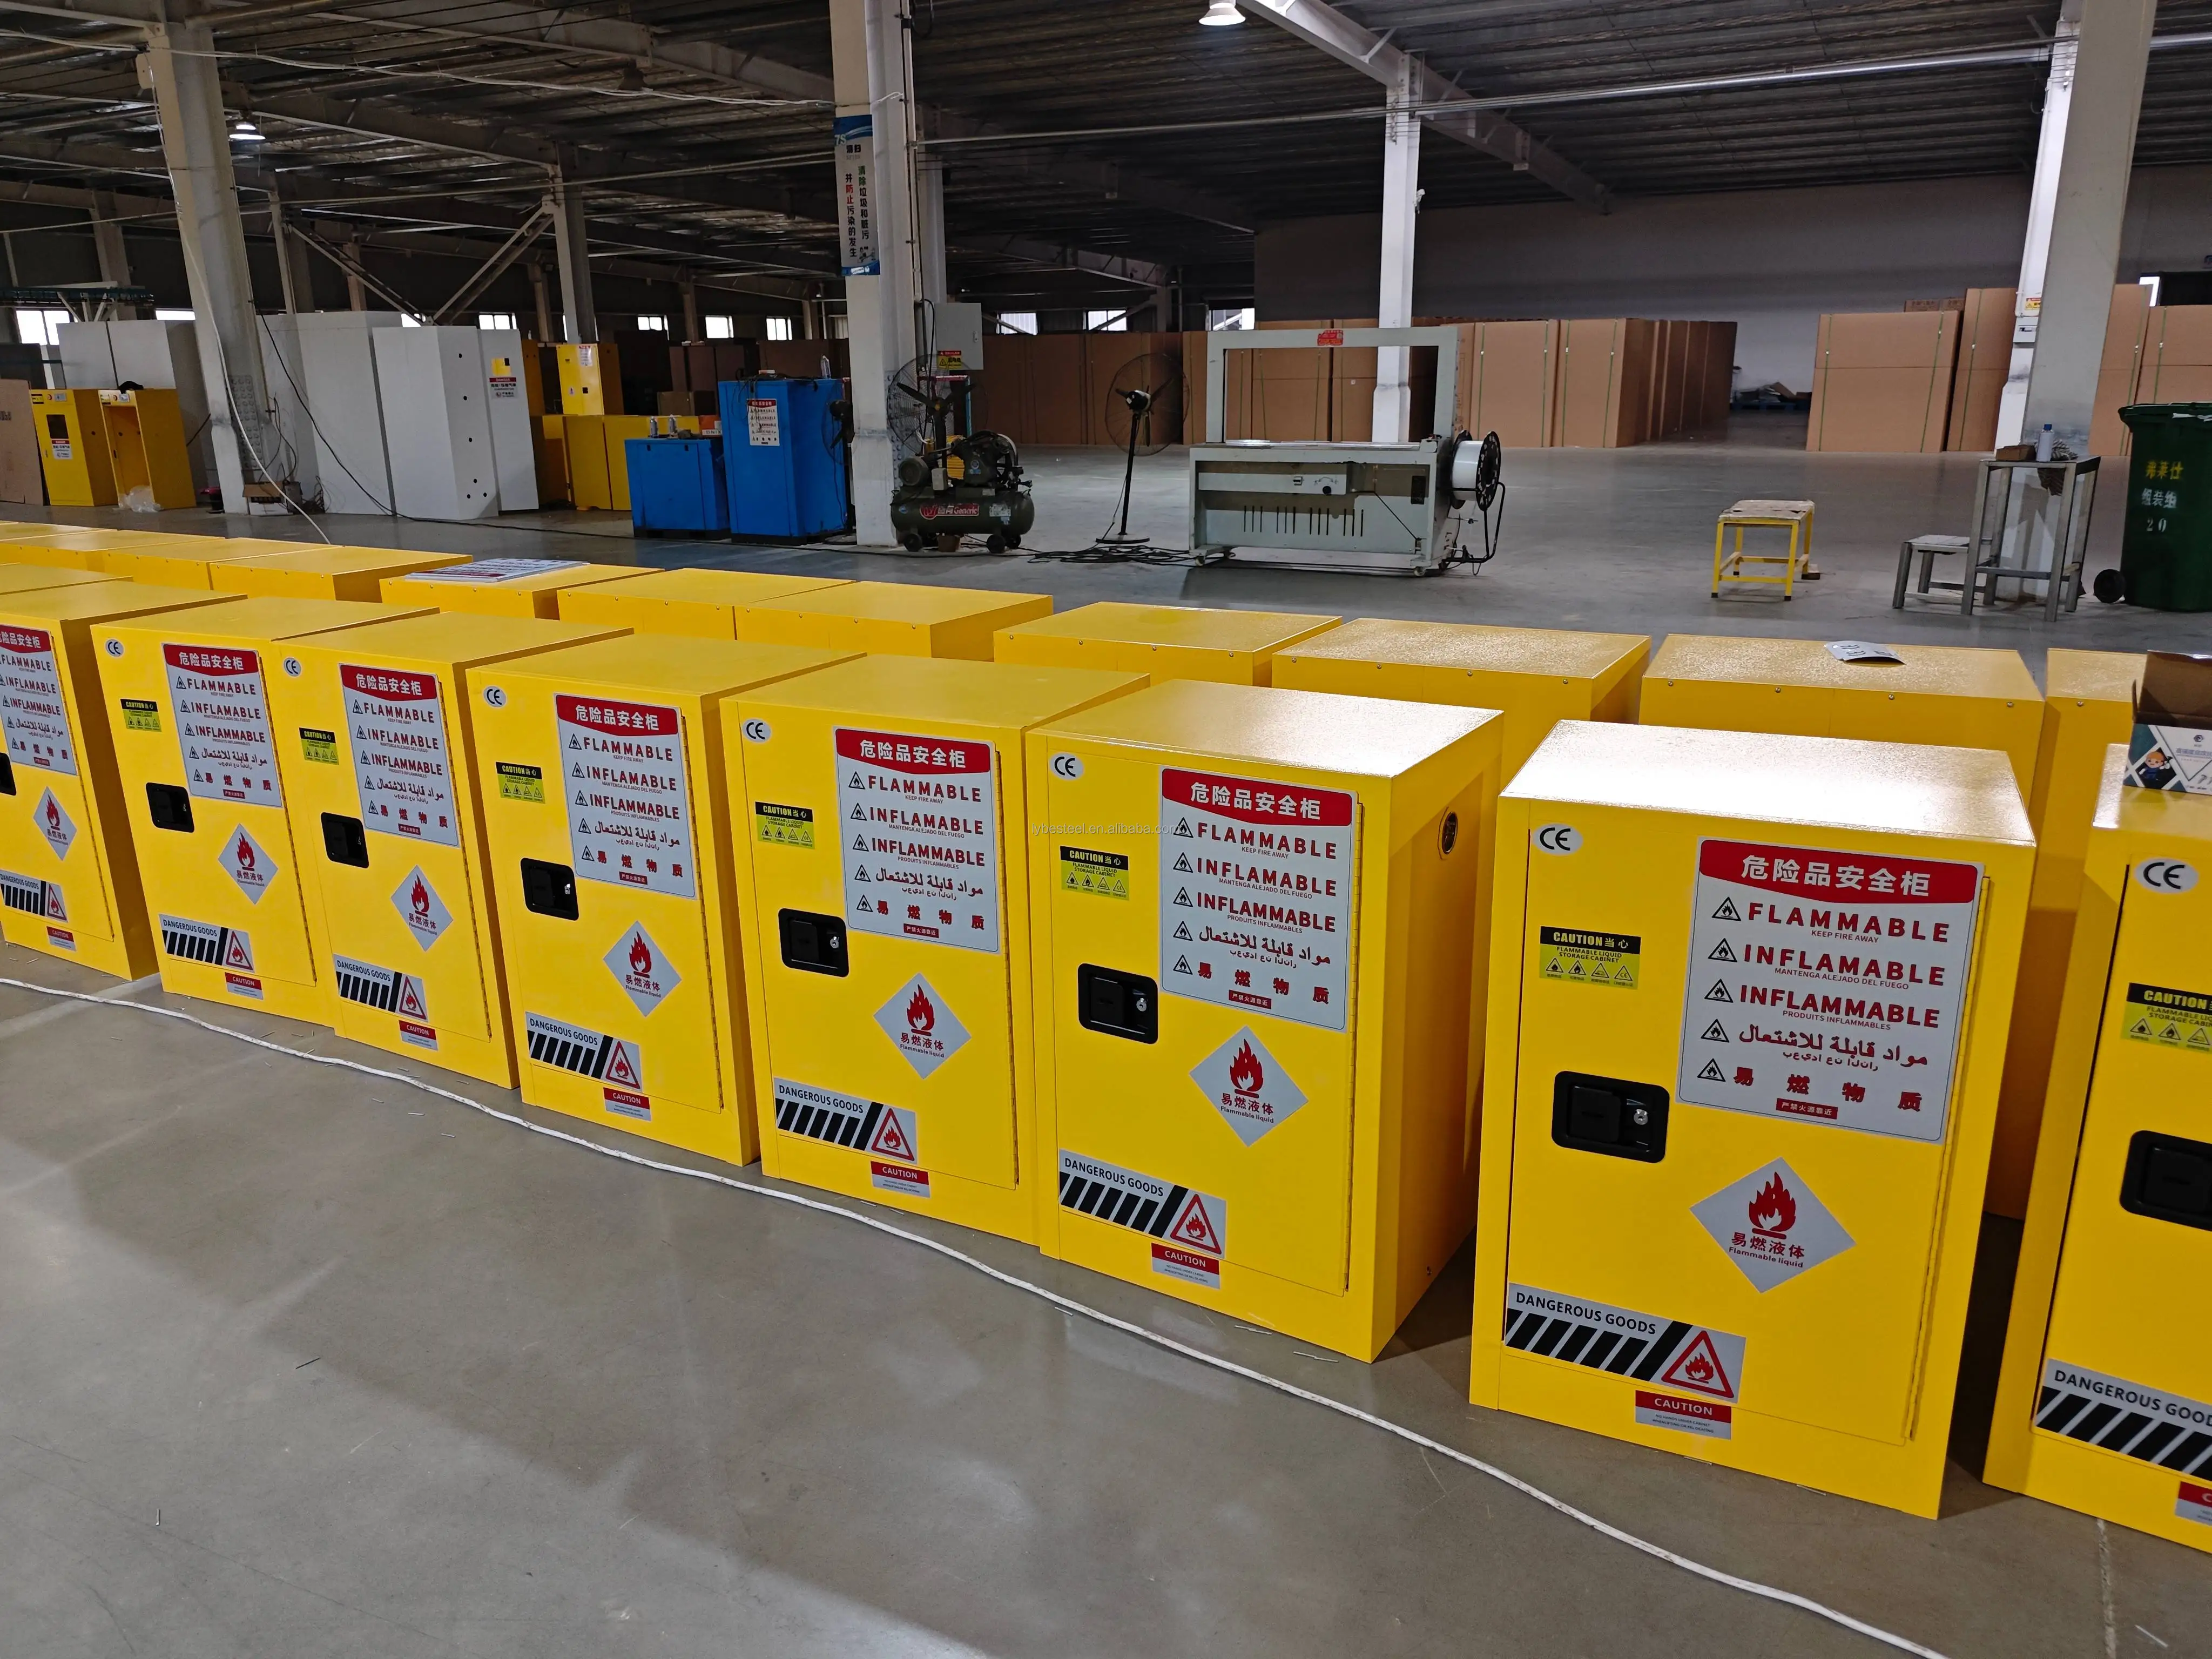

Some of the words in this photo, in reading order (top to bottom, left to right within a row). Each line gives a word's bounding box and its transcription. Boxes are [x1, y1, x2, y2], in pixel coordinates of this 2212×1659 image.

[834, 134, 846, 146] 7S
[107, 641, 120, 655] CE
[0, 655, 51, 673] FLAMMABLE
[179, 652, 244, 671] 危险品安全柜
[286, 660, 298, 675] CE
[5, 677, 56, 696] INFLAMABLE
[187, 678, 257, 695] FLAMMABLE
[356, 673, 422, 697] 危险品安全柜
[487, 688, 502, 705] CE
[10, 698, 60, 717] INFLAMMABLE
[191, 702, 261, 719] INFLAMABLE
[364, 702, 434, 723] FLAMMABLE
[574, 704, 659, 732] 危险品安全柜
[195, 725, 265, 744] INFLAMMABLE
[368, 728, 437, 750] INFLAMABLE
[746, 721, 765, 740] CE
[583, 737, 673, 762] FLAMMABLE
[859, 739, 966, 770] 危险品安全柜
[372, 753, 441, 775] INFLAMMABLE
[501, 765, 525, 775] CAUTION
[1054, 756, 1076, 777] CE
[586, 765, 677, 791] INFLAMABLE
[868, 775, 981, 802] FLAMMABLE
[589, 793, 679, 820] INFLAMMABLE
[763, 805, 792, 817] CAUTION
[1190, 781, 1321, 821] 危险品安全柜
[869, 807, 983, 835] INFLAMABLE
[888, 824, 915, 832] MANTENGA
[915, 827, 937, 835] ALEJADO
[1198, 822, 1337, 860] FLAMMABLE
[1539, 826, 1571, 852] CE
[872, 838, 985, 867] INFLAMMABLE
[897, 856, 922, 864] PRODUITS
[922, 860, 959, 869] INFLAMMABLES
[1069, 849, 1103, 864] CAUTION
[1242, 846, 1257, 854] KEEP
[1258, 848, 1271, 857] FIRE
[1272, 851, 1289, 859] AWAY
[1073, 862, 1101, 871] FLAMMABLE
[1741, 854, 1932, 898] 危险品安全柜
[2143, 862, 2184, 889] CE
[1197, 858, 1337, 897] INFLAMABLE
[1219, 878, 1251, 889] MANTENGA
[1252, 884, 1278, 894] ALEJADO
[1279, 888, 1291, 896] DEL
[1292, 890, 1312, 900] FUEGO
[408, 912, 437, 931] 易燃液体
[1197, 892, 1336, 933] INFLAMMABLE
[1748, 902, 1950, 943] FLAMMABLE
[163, 919, 197, 933] DANGEROUS
[197, 926, 218, 937] GOODS
[1227, 914, 1257, 925] PRODUITS
[1257, 920, 1303, 934] INFLAMMABLES
[1553, 932, 1603, 947] CAUTION
[1811, 929, 1833, 939] KEEP
[1834, 932, 1853, 941] FIRE
[1854, 934, 1879, 943] AWAY
[1557, 946, 1597, 955] FLAMMABLE
[1599, 951, 1622, 959] LIQUID
[1559, 952, 1589, 960] STORAGE
[1590, 955, 1620, 963] CABINET
[337, 959, 371, 976] DANGEROUS
[371, 969, 391, 982] GOODS
[1743, 944, 1946, 986] INFLAMABLE
[232, 976, 255, 986] CAUTION
[625, 974, 660, 993] 易燃液体
[1774, 967, 1820, 980] MANTENGA
[1821, 973, 1859, 984] ALEJADO
[1861, 977, 1879, 987] DEL
[1879, 980, 1909, 990] FUEGO
[1739, 984, 1940, 1028] INFLAMMABLE
[2144, 990, 2207, 1009] CAUTION
[1782, 1010, 1825, 1022] PRODUITS
[1826, 1016, 1891, 1031] INFLAMMABLES
[2147, 1006, 2198, 1019] FLAMMABLE
[2149, 1013, 2187, 1023] STORAGE
[406, 1024, 430, 1036] CAUTION
[530, 1017, 572, 1038] DANGEROUS
[573, 1030, 598, 1046] GOODS
[1738, 1023, 1823, 1053] للاشتعال
[900, 1032, 944, 1052] 易燃液体
[900, 1044, 928, 1055] Flammable
[929, 1050, 944, 1059] liquid
[1828, 1035, 1876, 1061] قابلة
[1881, 1043, 1930, 1071] مواد
[612, 1092, 640, 1104] CAUTION
[779, 1084, 831, 1106] DANGEROUS
[833, 1097, 864, 1114] GOODS
[1221, 1092, 1274, 1117] 易燃液体
[1220, 1105, 1255, 1119] Flammable
[1256, 1114, 1274, 1124] liquid
[1781, 1101, 1833, 1116] 严禁火源靠近
[882, 1166, 918, 1179] CAUTION
[1065, 1157, 1125, 1185] DANGEROUS
[1128, 1177, 1163, 1198] GOODS
[1730, 1231, 1806, 1260] 易燃液体
[1165, 1250, 1206, 1267] CAUTION
[1728, 1246, 1777, 1263] Flammable
[1778, 1257, 1804, 1269] liquid
[1516, 1292, 1602, 1323] DANGEROUS
[1604, 1312, 1656, 1335] GOODS
[2054, 1370, 2161, 1411] DANGEROUS
[1654, 1398, 1712, 1415] CAUTION
